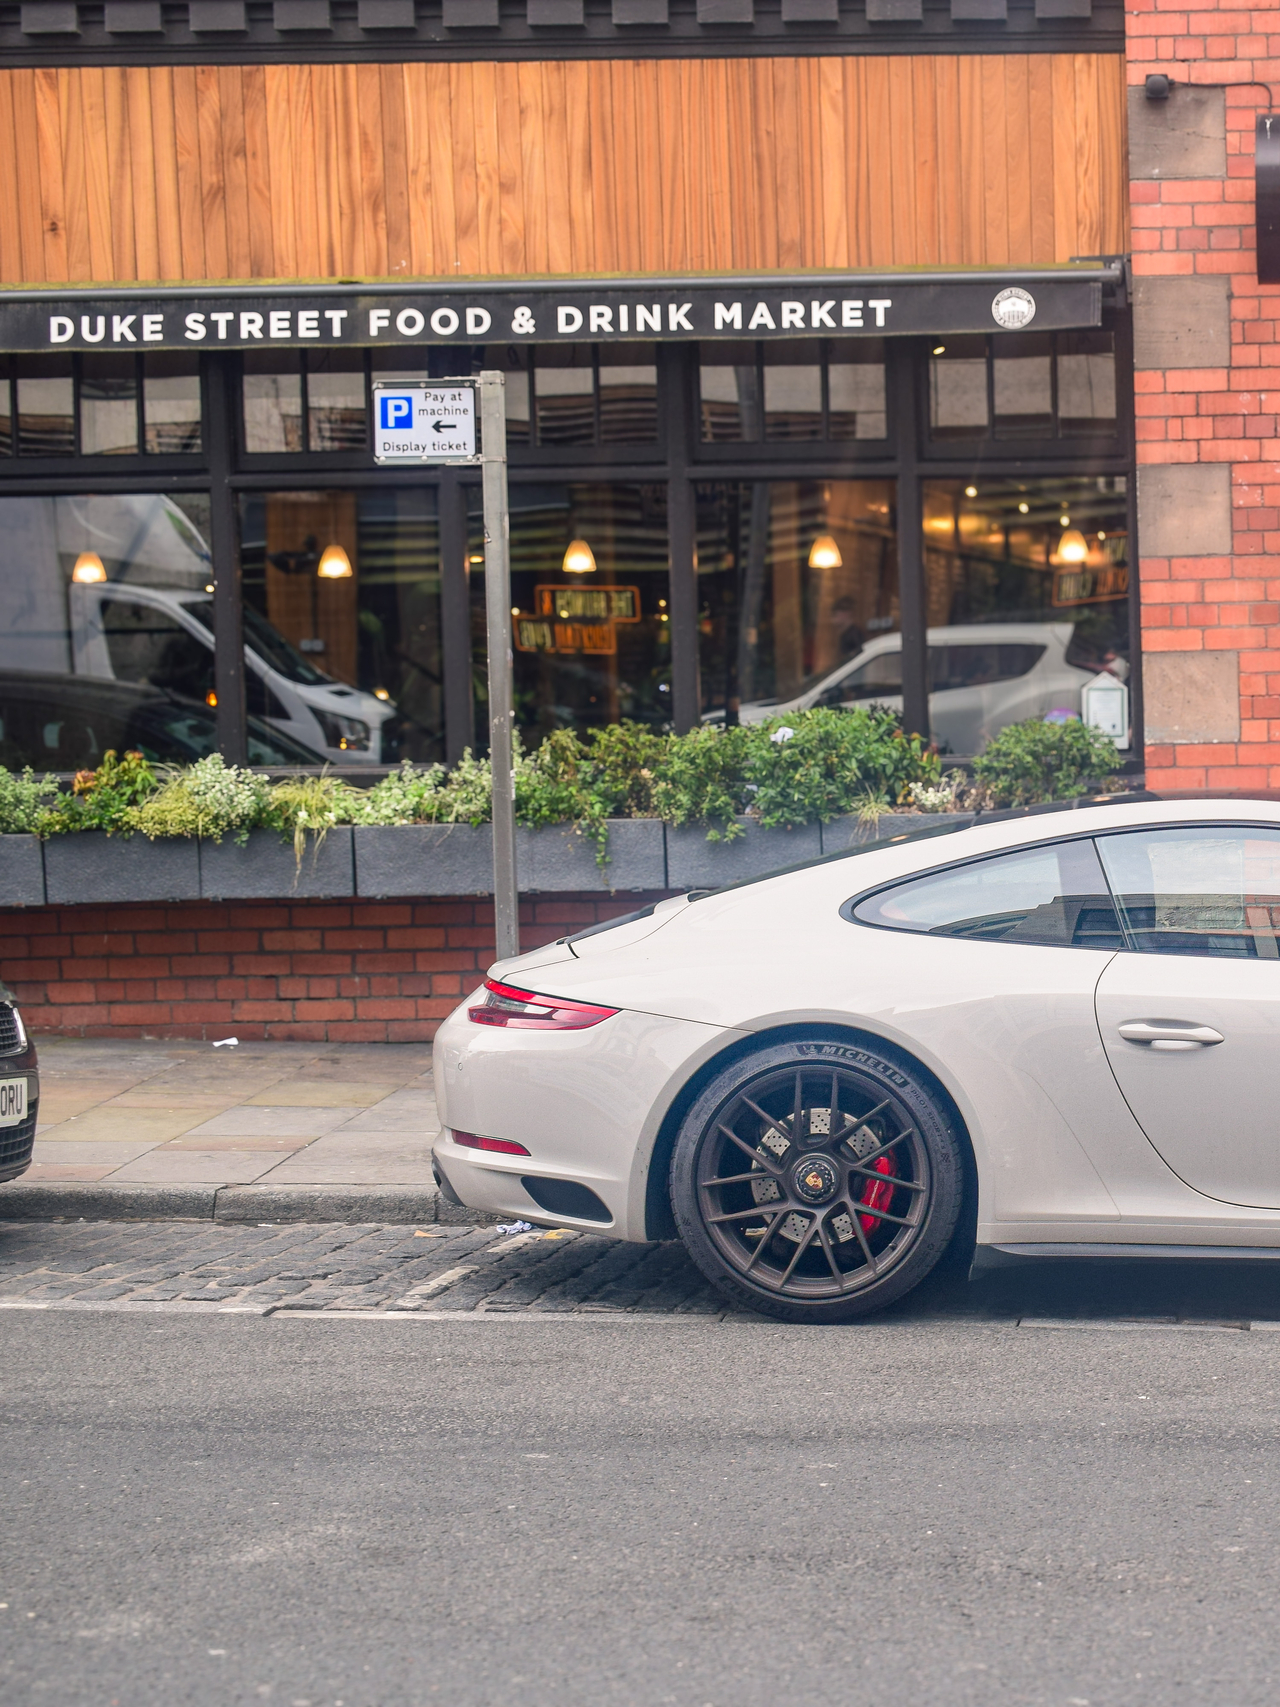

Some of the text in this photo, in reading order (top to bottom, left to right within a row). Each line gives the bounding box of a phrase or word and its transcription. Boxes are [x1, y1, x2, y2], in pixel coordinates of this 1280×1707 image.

[50, 300, 891, 342] DUKE STREET FOOD & DRINK MARKET
[424, 392, 463, 403] Pay at
[387, 399, 410, 428] P
[418, 406, 470, 416] machine
[383, 441, 468, 453] Display ticket
[821, 1045, 905, 1085] MICHELIN
[911, 1089, 928, 1109] PILOT
[927, 1111, 943, 1137] SPORT
